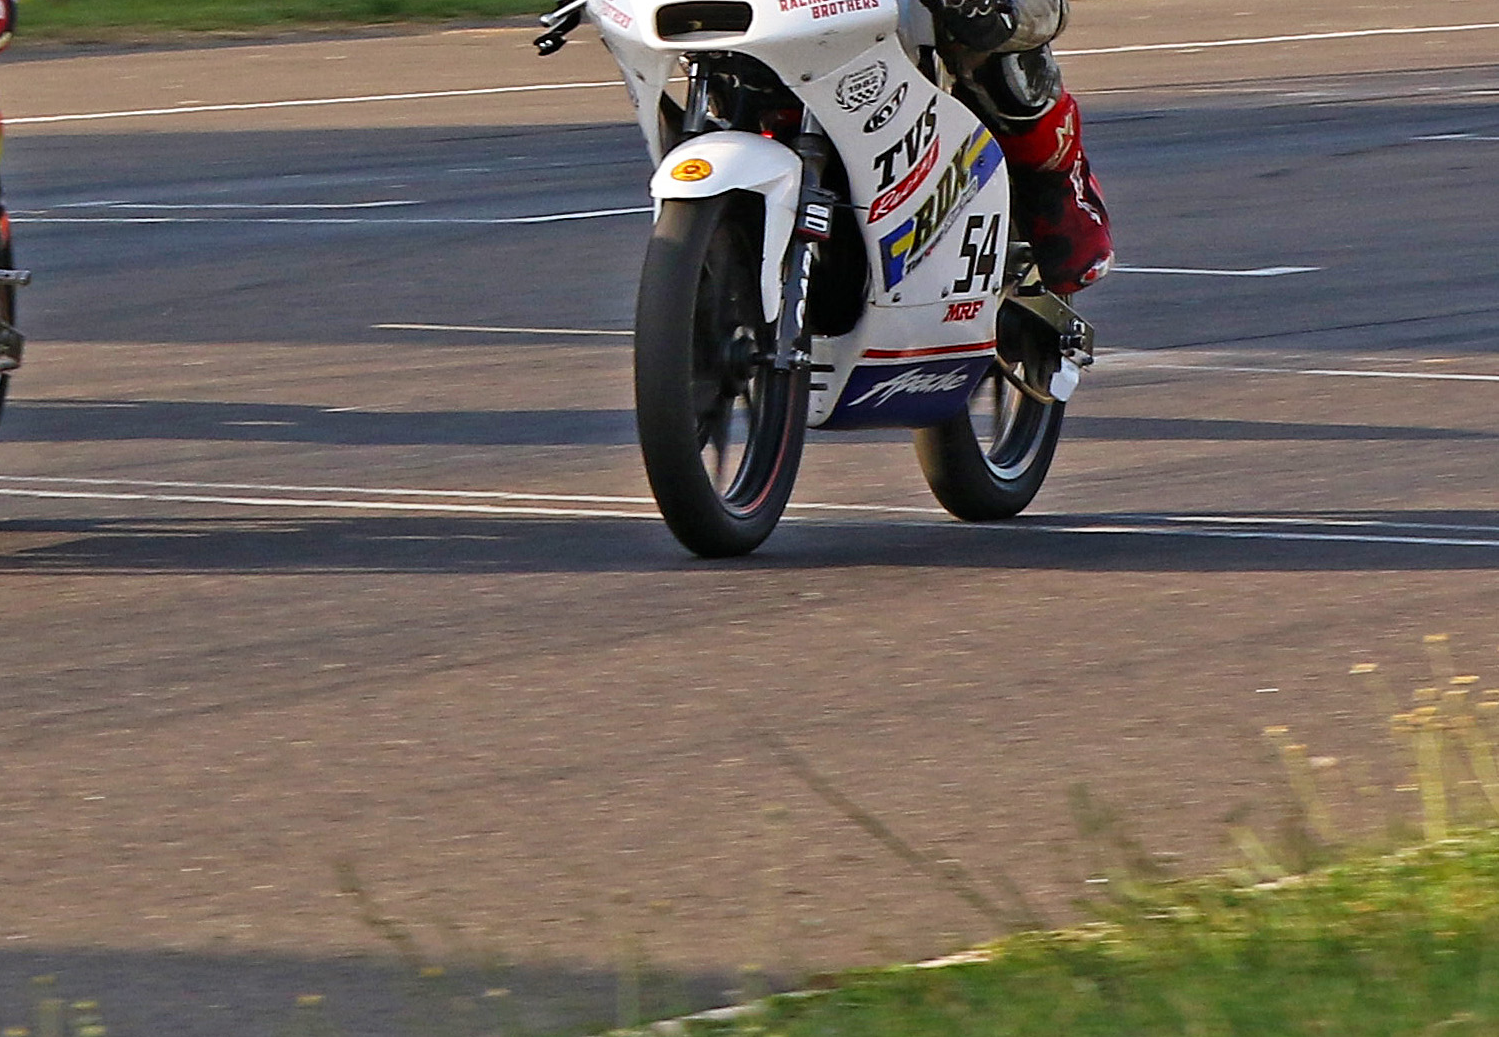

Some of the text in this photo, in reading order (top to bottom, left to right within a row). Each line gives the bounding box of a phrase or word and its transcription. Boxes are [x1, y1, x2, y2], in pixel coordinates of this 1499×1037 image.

[867, 84, 906, 130] KYT
[873, 93, 938, 193] TVS
[953, 214, 1000, 293] 54
[942, 300, 984, 323] MRF
